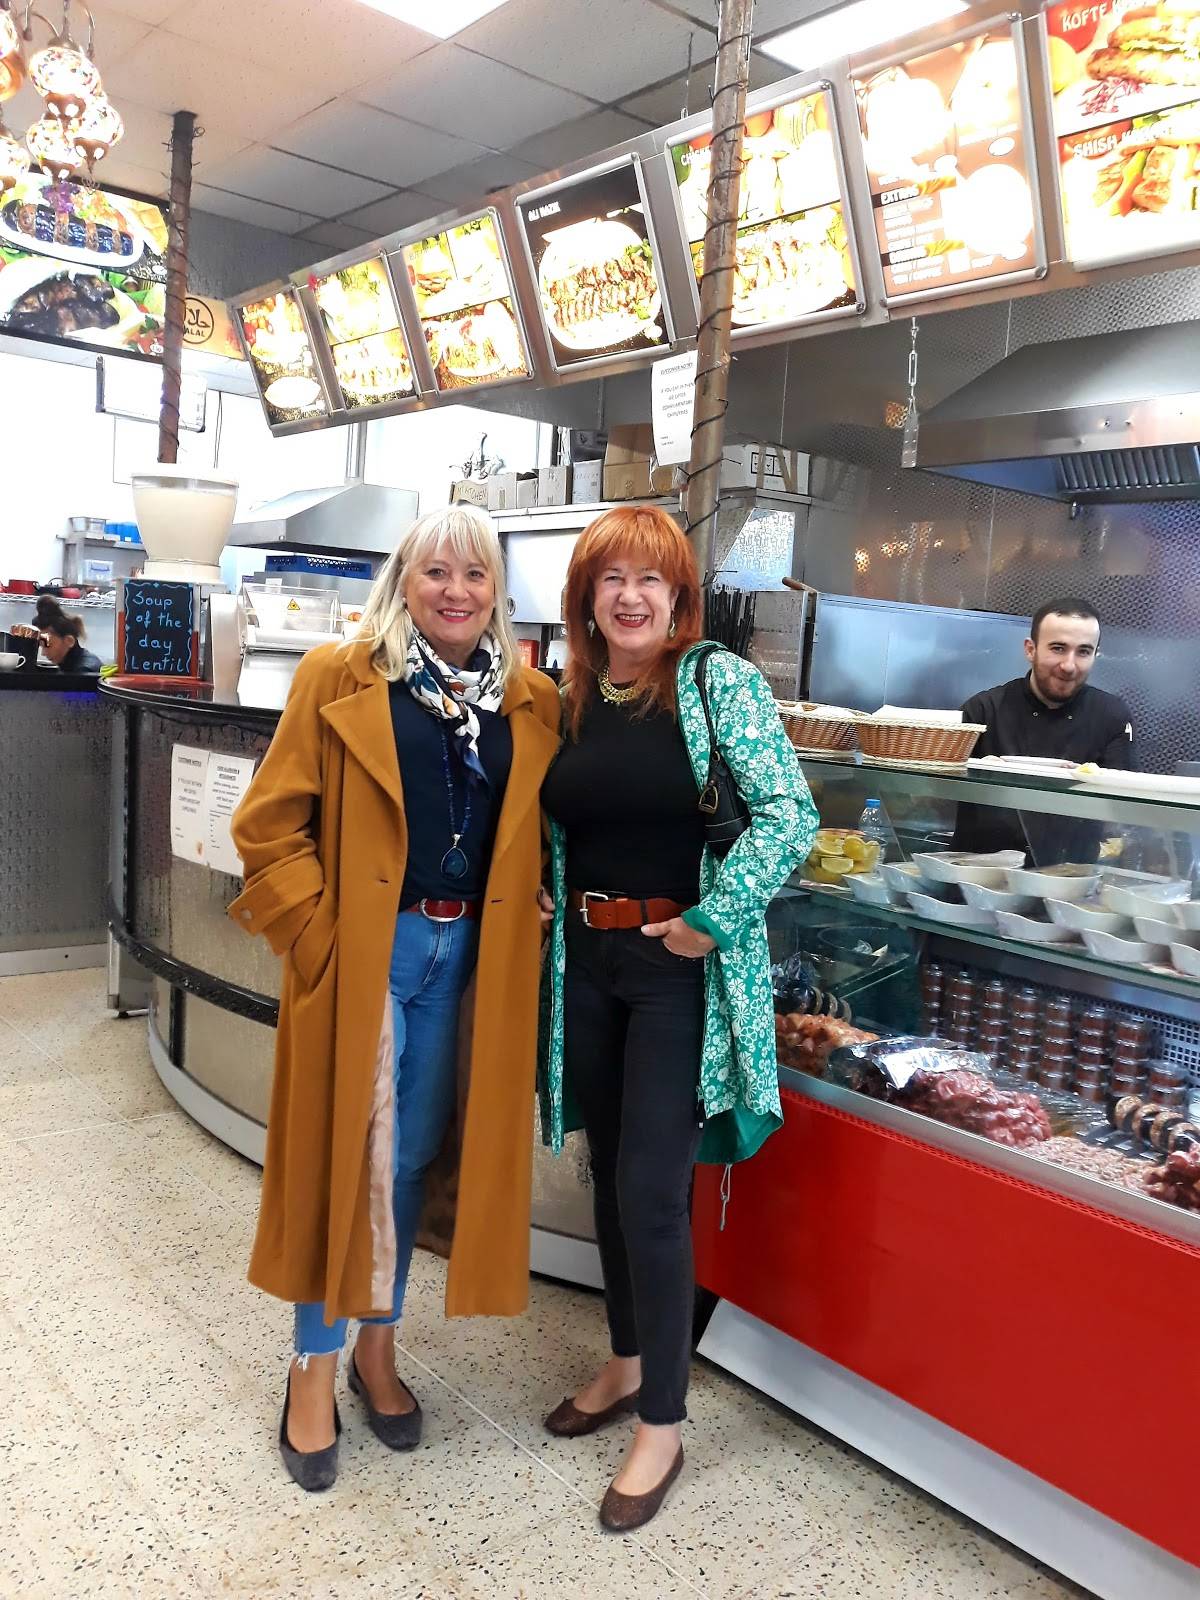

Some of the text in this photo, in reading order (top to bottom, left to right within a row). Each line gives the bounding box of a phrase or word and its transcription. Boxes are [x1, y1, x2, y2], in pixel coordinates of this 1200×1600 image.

[1062, 3, 1108, 33] KOFTE
[1073, 134, 1119, 157] SHISH
[681, 147, 711, 167] CHICKE
[184, 327, 206, 338] ALAL
[132, 591, 173, 610] Soup
[136, 610, 182, 629] of the
[139, 634, 172, 656] day
[131, 655, 184, 672] Lentil
